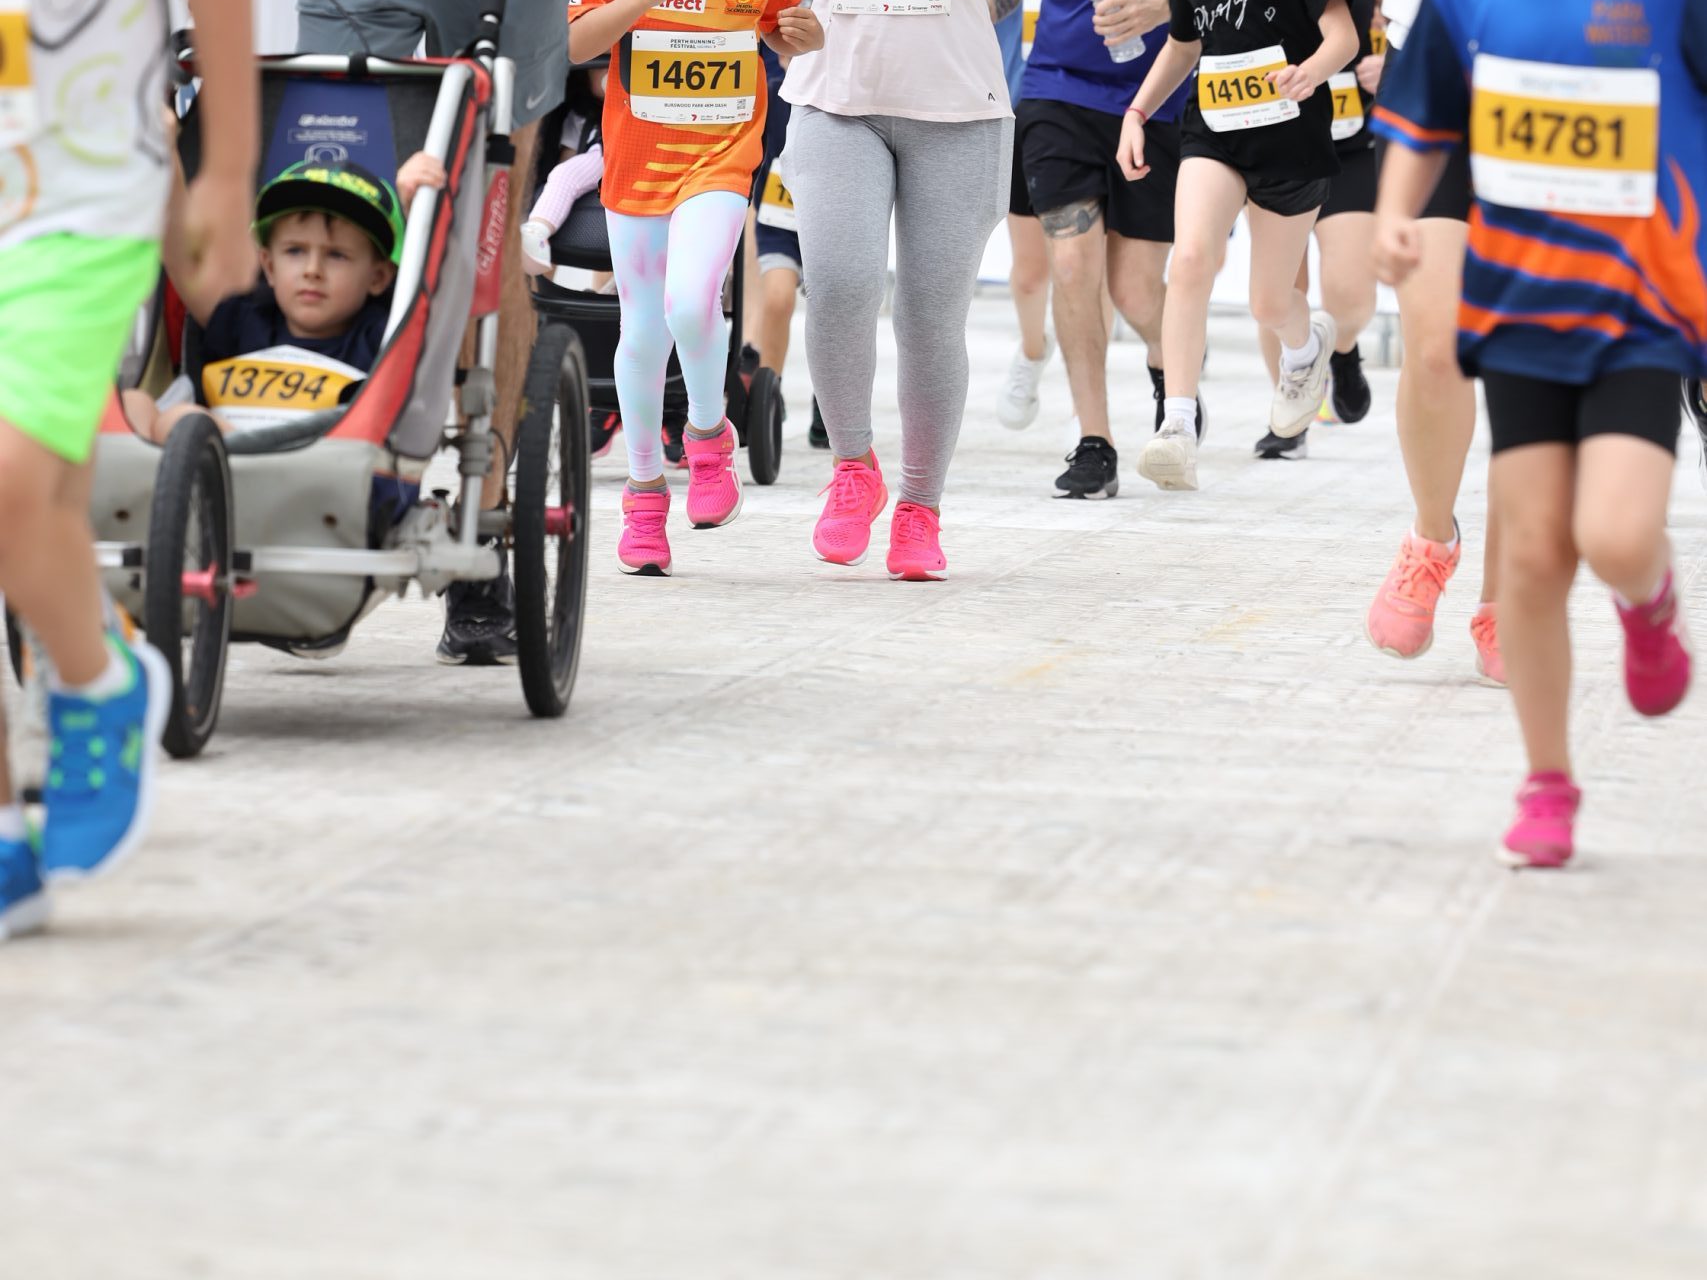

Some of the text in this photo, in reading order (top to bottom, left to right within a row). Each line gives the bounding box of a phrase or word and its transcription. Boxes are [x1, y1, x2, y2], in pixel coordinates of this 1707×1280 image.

[646, 59, 741, 90] 14671
[1490, 106, 1626, 160] 14781
[218, 365, 329, 401] 13794
